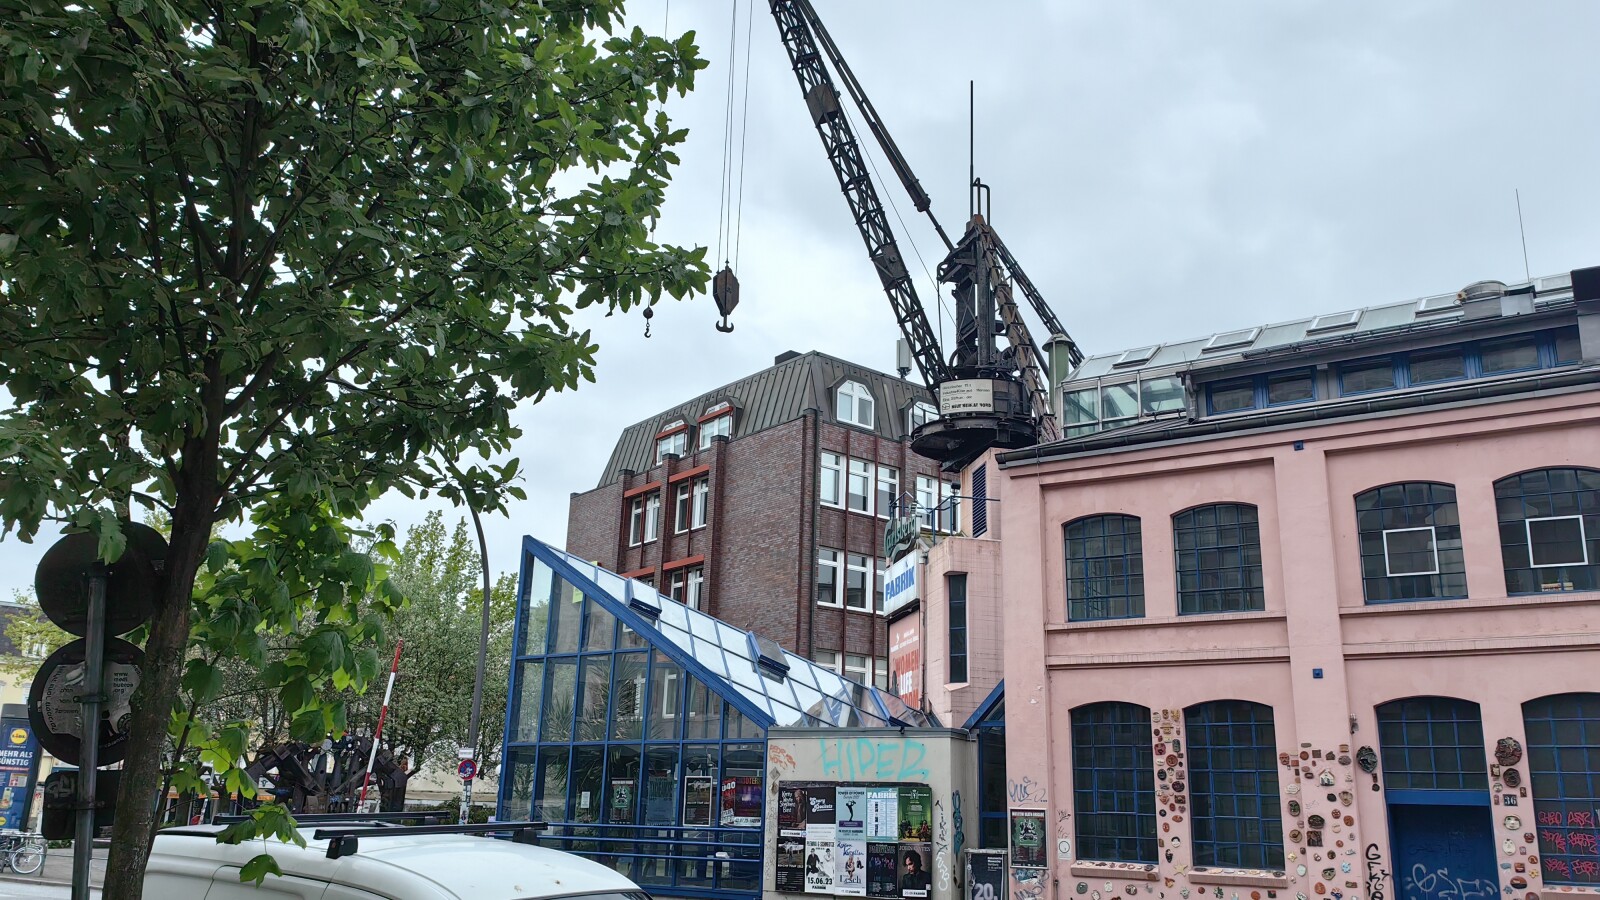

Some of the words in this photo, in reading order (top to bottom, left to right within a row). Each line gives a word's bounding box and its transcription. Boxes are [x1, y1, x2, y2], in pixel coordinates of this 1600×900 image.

[884, 515, 917, 558] Carlsberg
[885, 566, 915, 602] FABRIK
[895, 649, 919, 677] WOMEN
[900, 671, 912, 696] LIFE
[0, 750, 18, 758] MEHR
[1504, 796, 1516, 805] 36
[808, 877, 832, 885] 15.06.23
